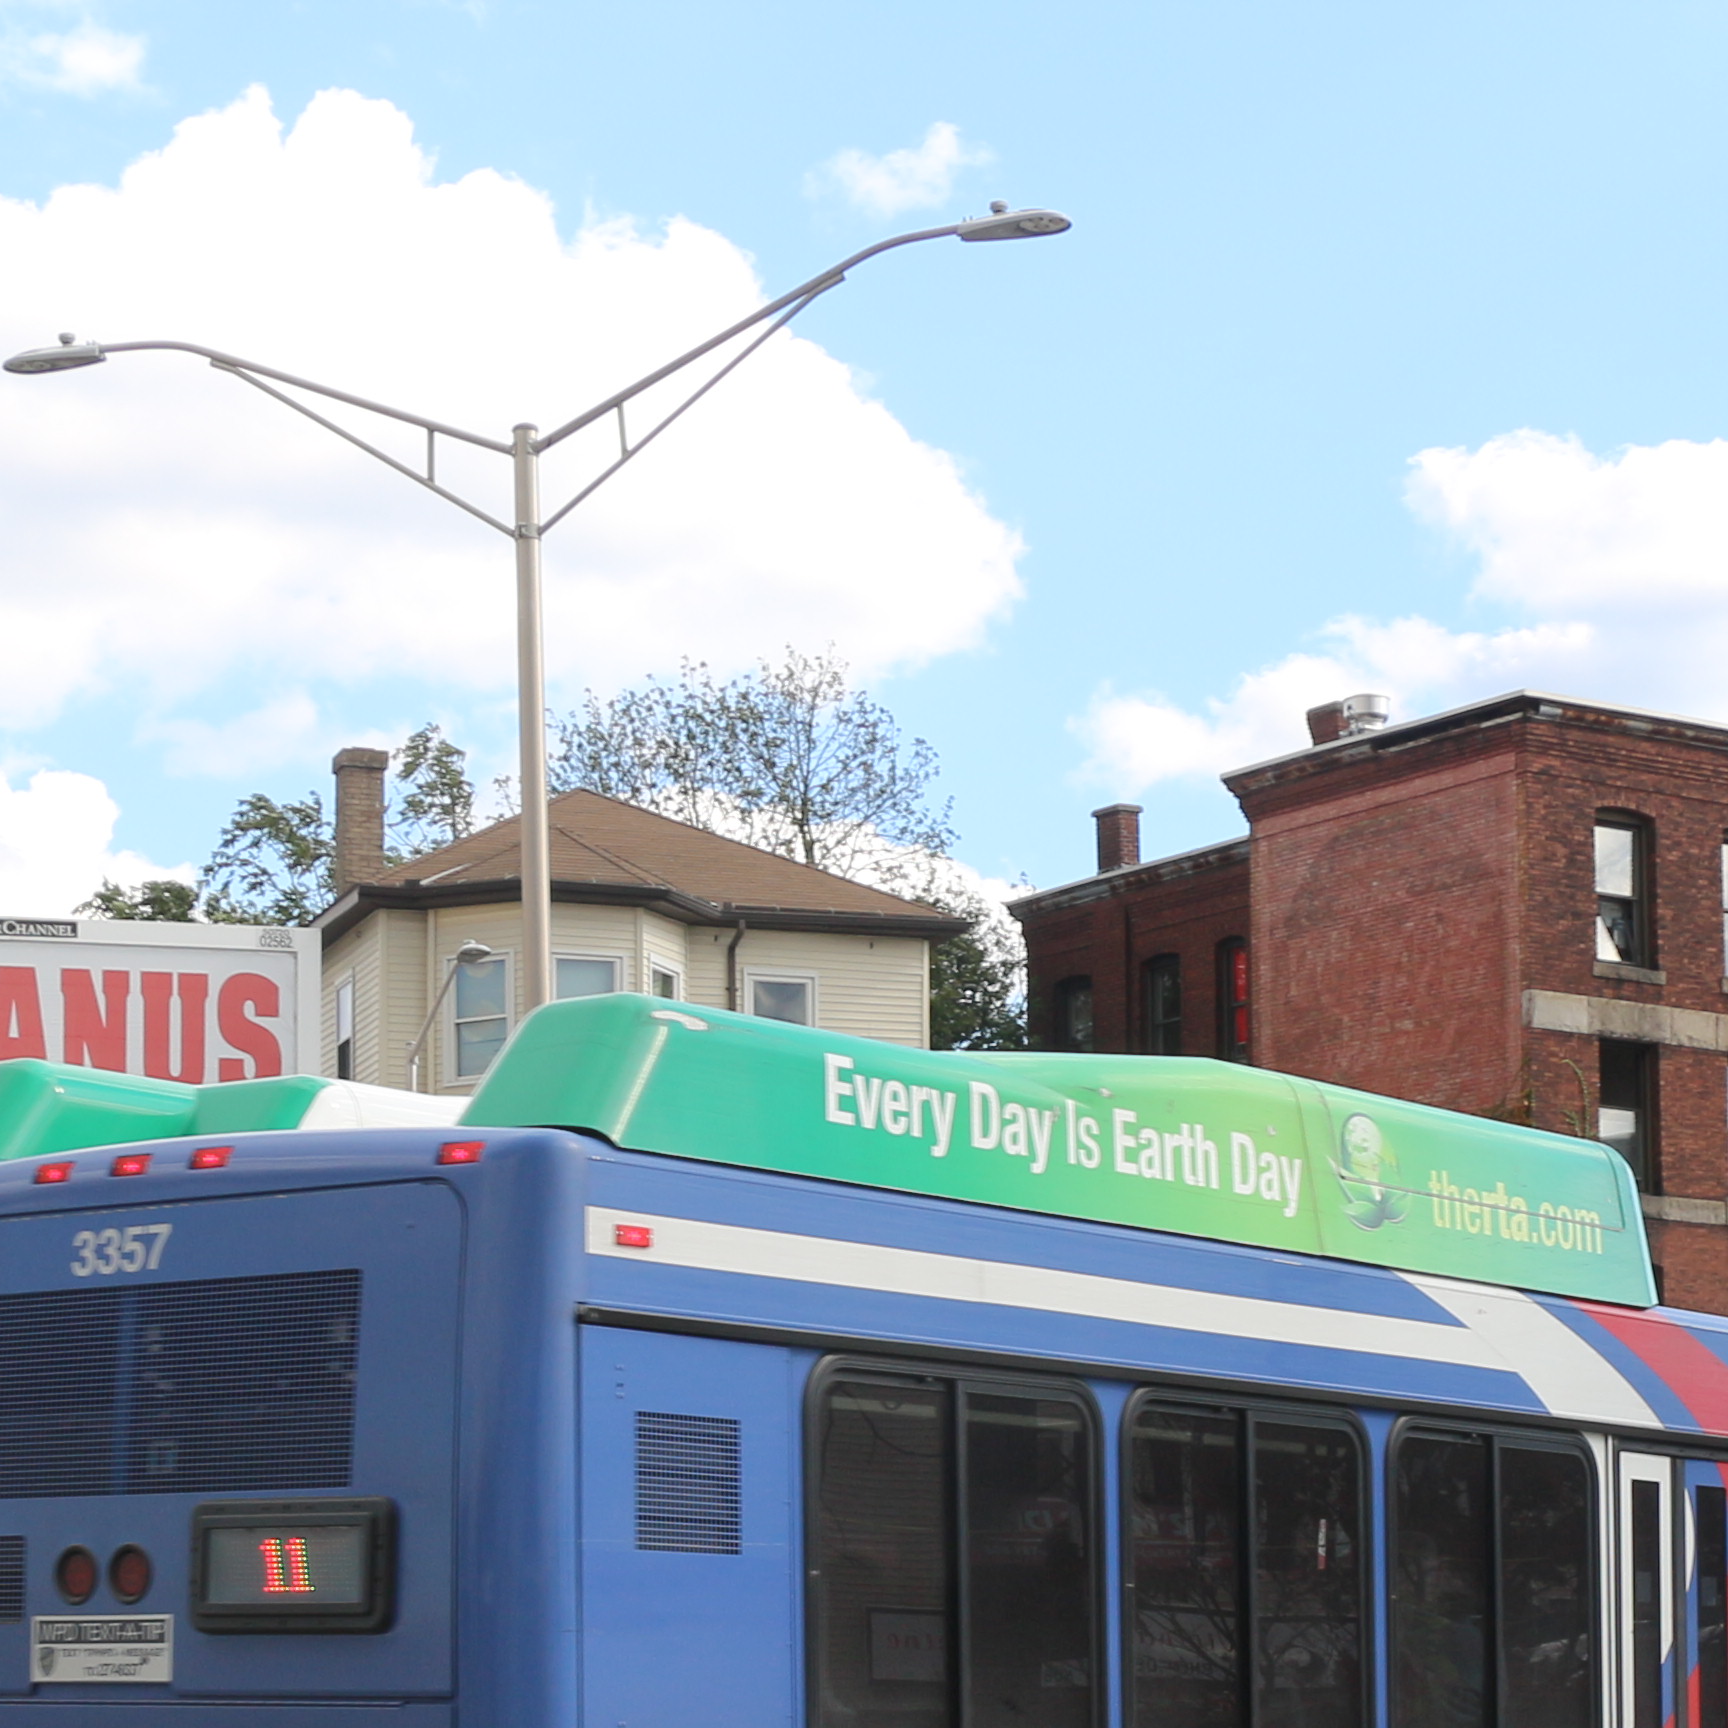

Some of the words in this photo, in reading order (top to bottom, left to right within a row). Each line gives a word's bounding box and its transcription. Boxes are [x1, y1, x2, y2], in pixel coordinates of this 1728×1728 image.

[823, 1052, 957, 1158] Every
[968, 1081, 1054, 1175] Day
[1065, 1099, 1102, 1169] Is
[1112, 1108, 1220, 1190] Earth
[1230, 1131, 1303, 1218] Day
[1428, 1169, 1604, 1255] therta.com
[70, 1223, 173, 1277] 3357
[258, 1536, 316, 1593] 11
